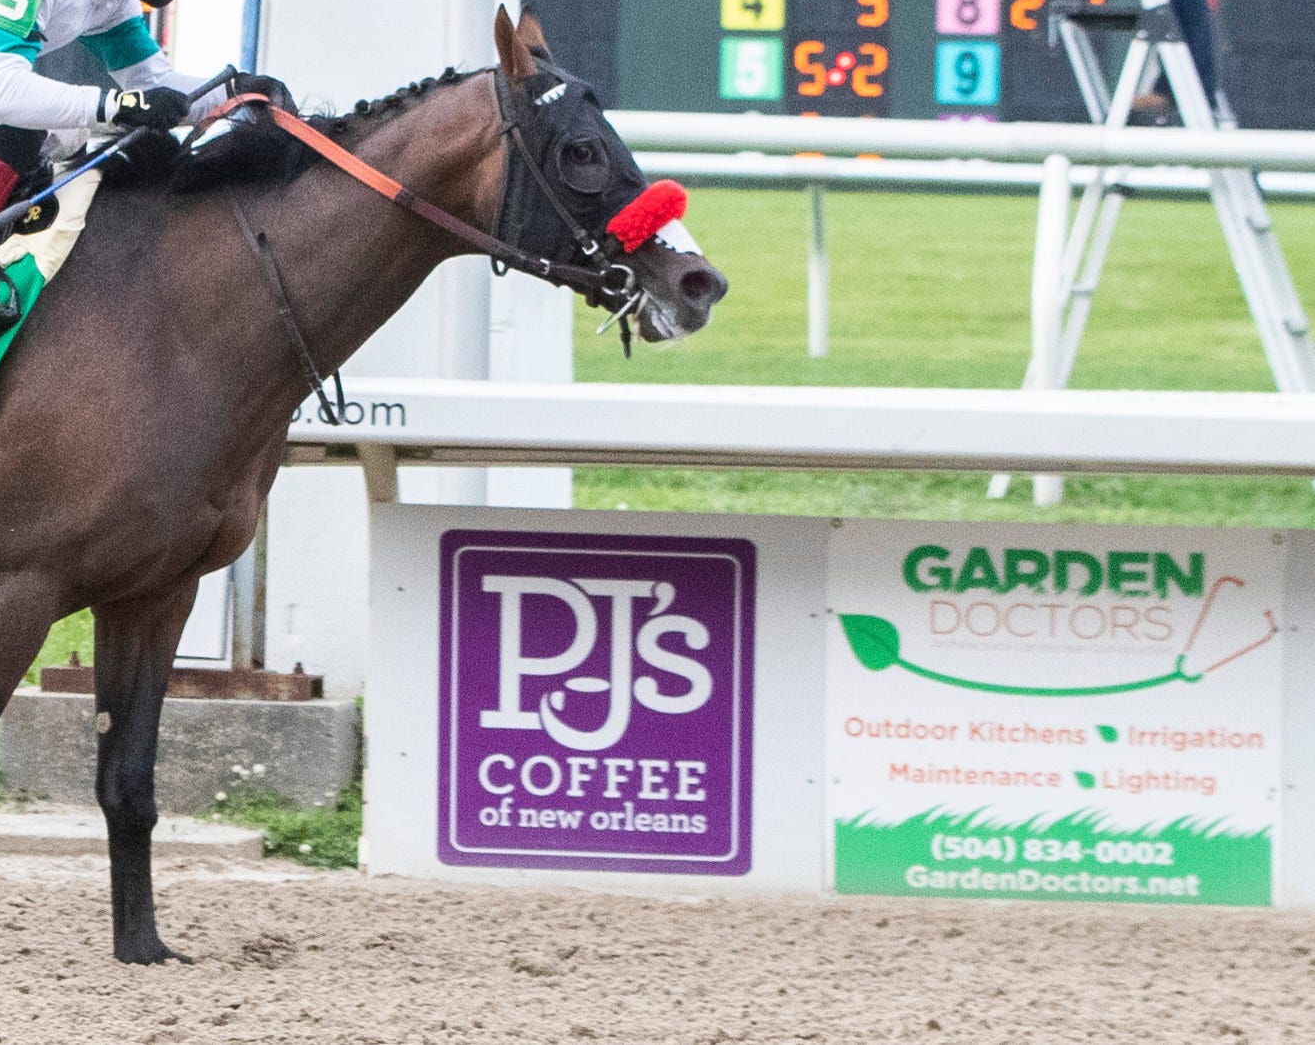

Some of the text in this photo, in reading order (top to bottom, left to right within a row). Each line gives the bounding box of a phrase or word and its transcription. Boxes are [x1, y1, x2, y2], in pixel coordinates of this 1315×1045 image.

[735, 41, 767, 96] 5
[955, 50, 981, 96] 9
[902, 544, 1205, 600] GARDEN
[929, 599, 1175, 642] DOCTORS
[844, 717, 1265, 751] Outdoor Kitchens Irrigation
[477, 754, 707, 802] COFFEE
[889, 762, 1217, 795] Maintenance Lighting
[478, 797, 708, 834] of new orleans
[930, 833, 1174, 866] (504) 834-0002
[905, 866, 1201, 898] GardenDoctors.net
